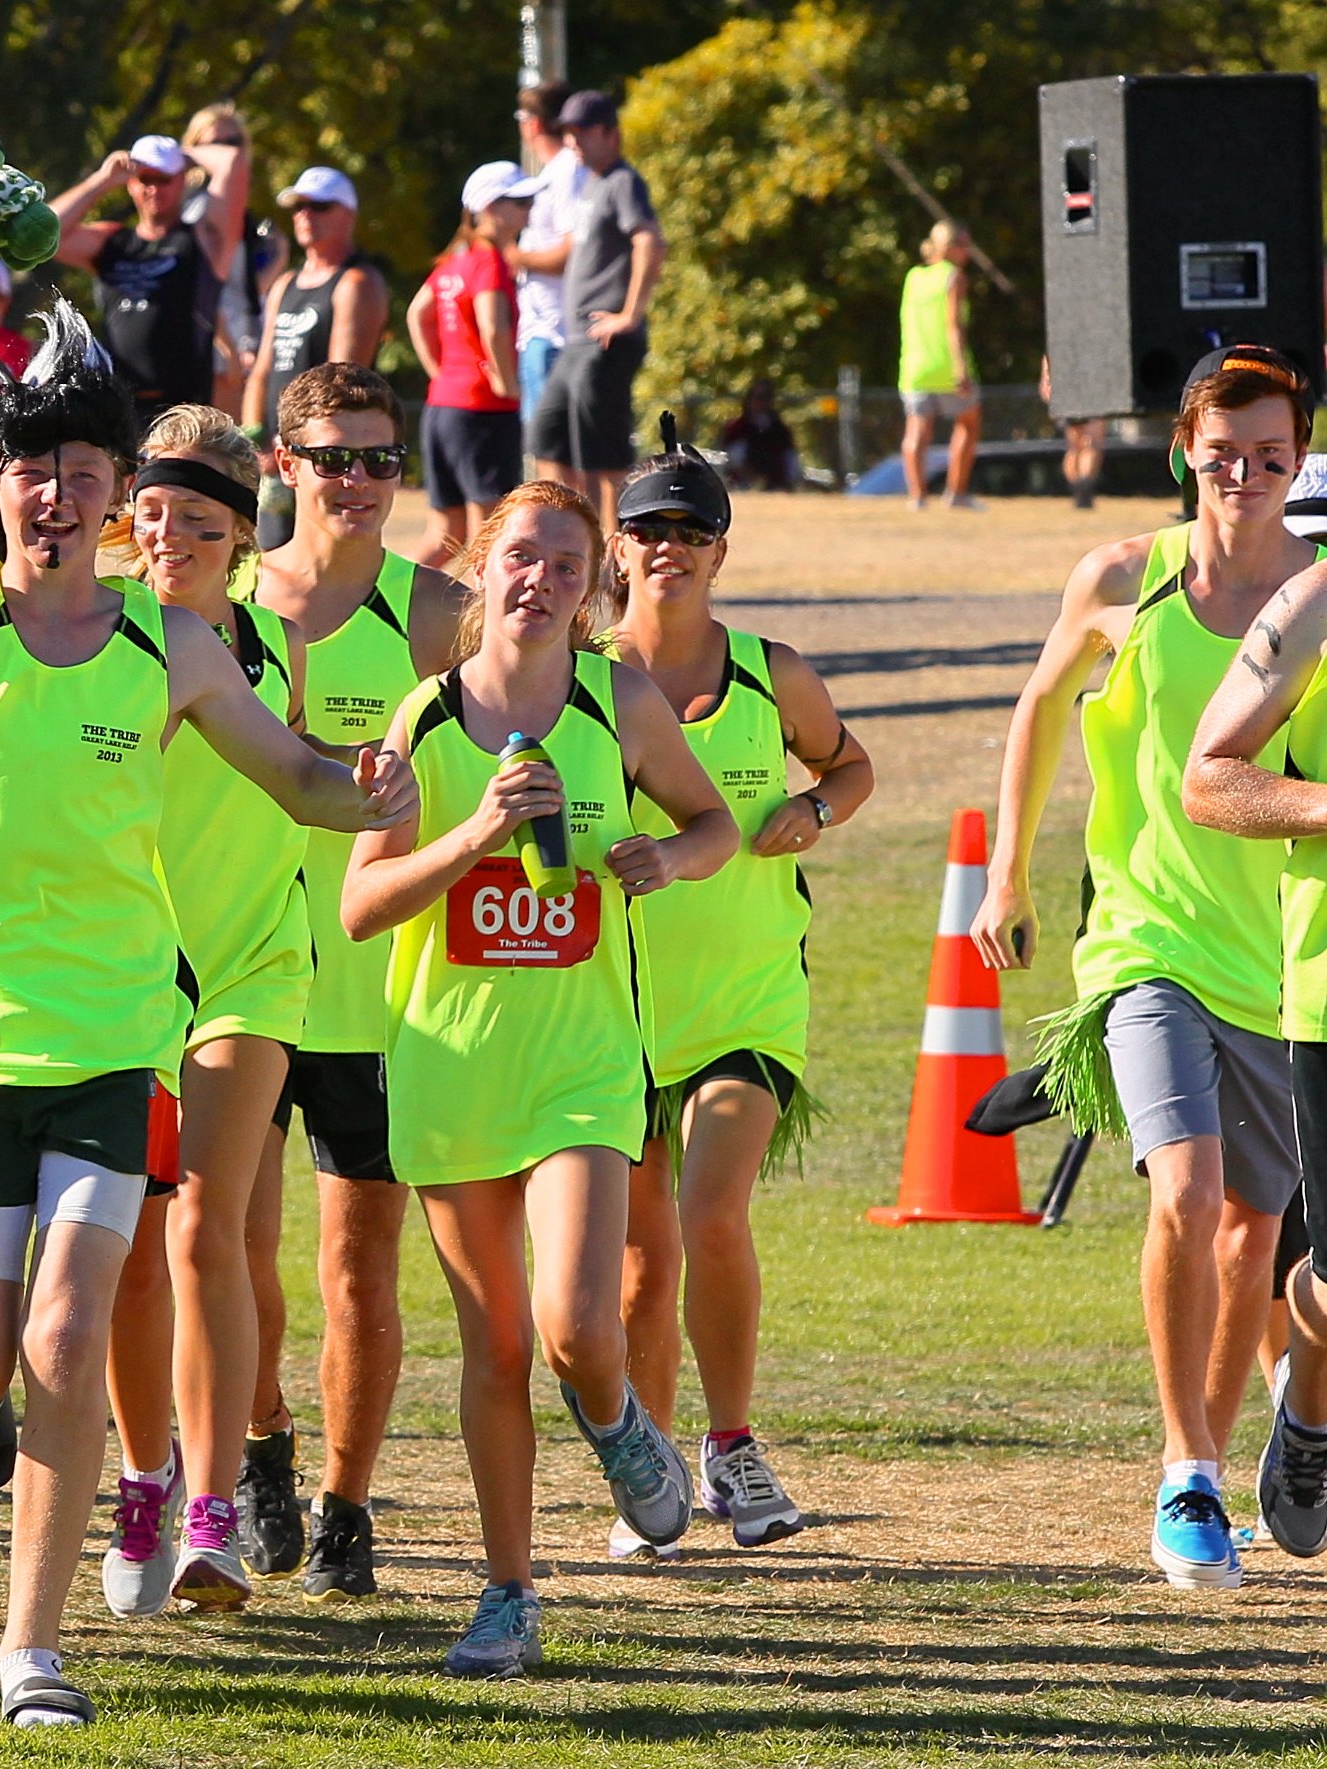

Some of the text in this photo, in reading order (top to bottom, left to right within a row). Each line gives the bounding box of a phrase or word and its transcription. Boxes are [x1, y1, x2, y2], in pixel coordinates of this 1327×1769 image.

[325, 697, 385, 708] THE TRIBE
[341, 717, 366, 727] 2013
[81, 724, 141, 743] THE TRIBE
[81, 736, 104, 744] GREAT
[105, 739, 122, 747] LAKE
[97, 749, 123, 763] 2013
[722, 769, 769, 779] THE TRIBE
[737, 790, 757, 799] 2013
[571, 802, 605, 812] TRIBE
[570, 823, 588, 833] 013
[472, 886, 575, 936] 608
[498, 939, 548, 948] The Tribe
